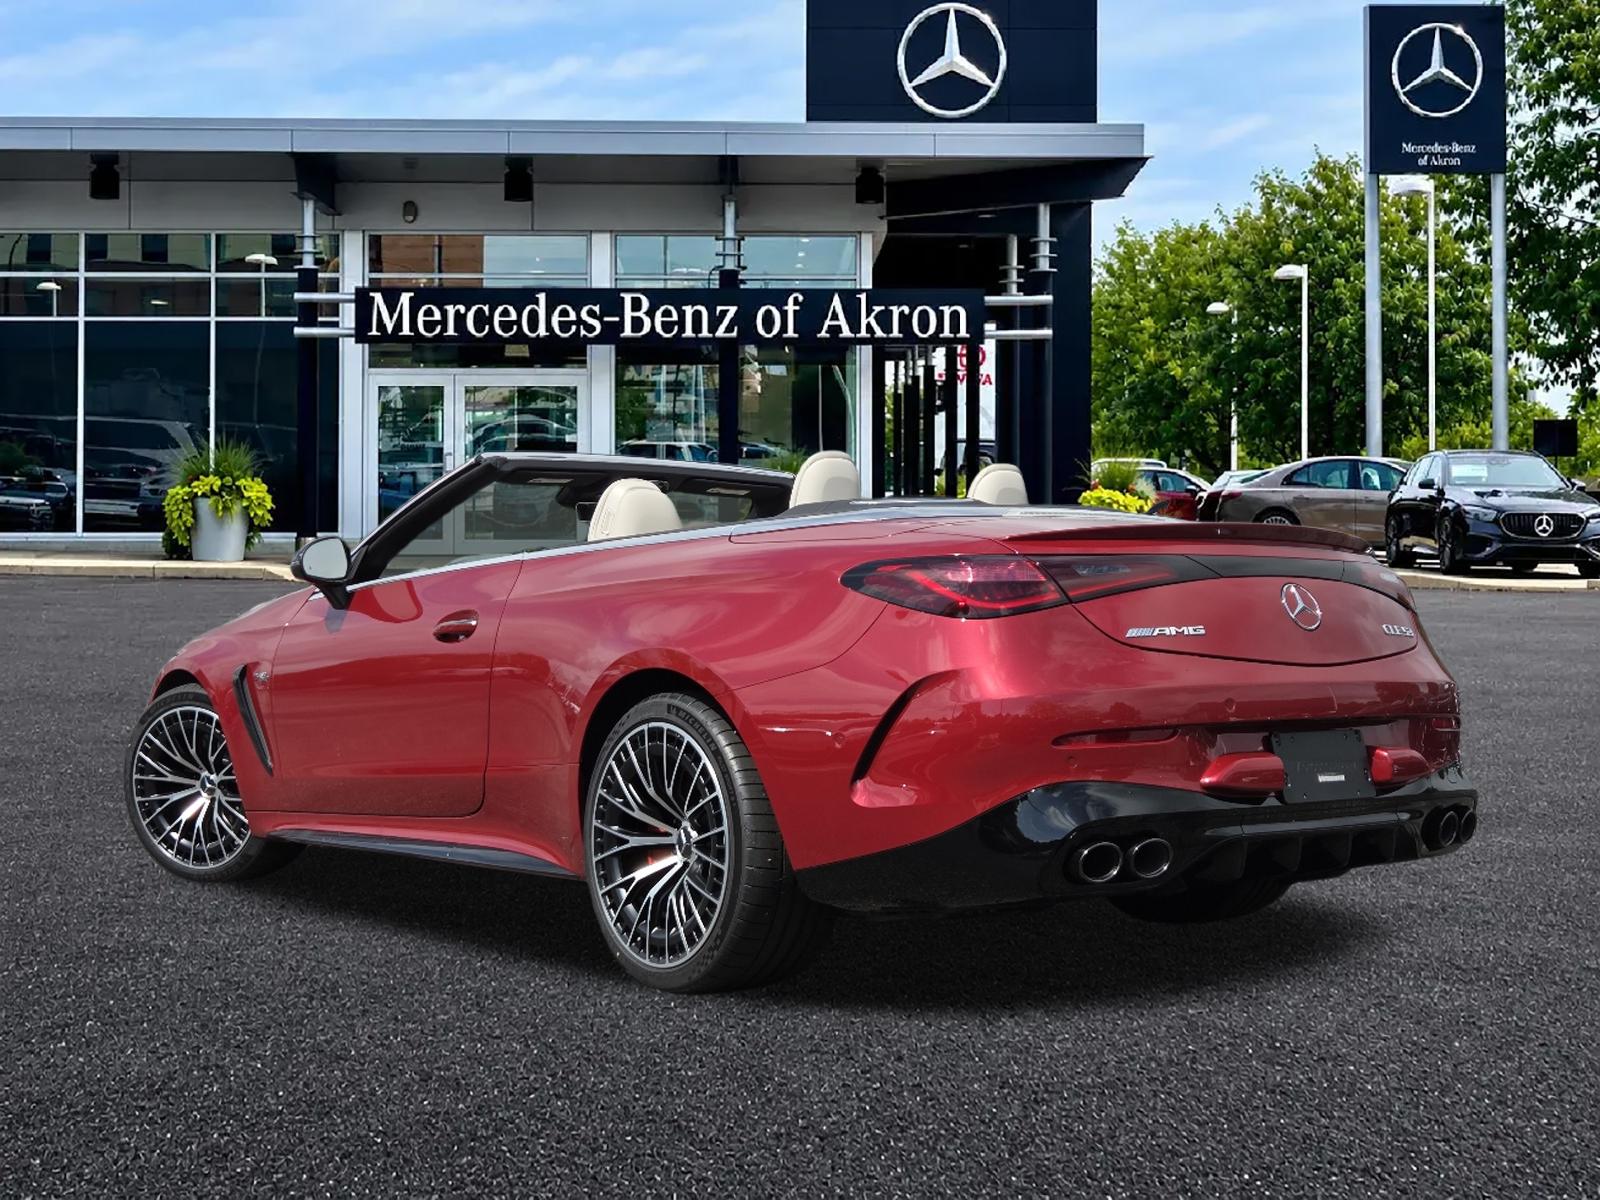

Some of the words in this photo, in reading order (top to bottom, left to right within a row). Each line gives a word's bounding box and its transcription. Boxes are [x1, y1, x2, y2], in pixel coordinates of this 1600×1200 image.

[1401, 142, 1476, 154] Mercedes-Benz
[1417, 154, 1428, 166] of
[1430, 154, 1461, 166] Akron
[367, 291, 738, 338] Mercedes-Benz
[756, 292, 804, 338] of
[817, 292, 970, 338] Akron
[1152, 625, 1206, 636] AMG
[677, 708, 718, 751] MICHELIN
